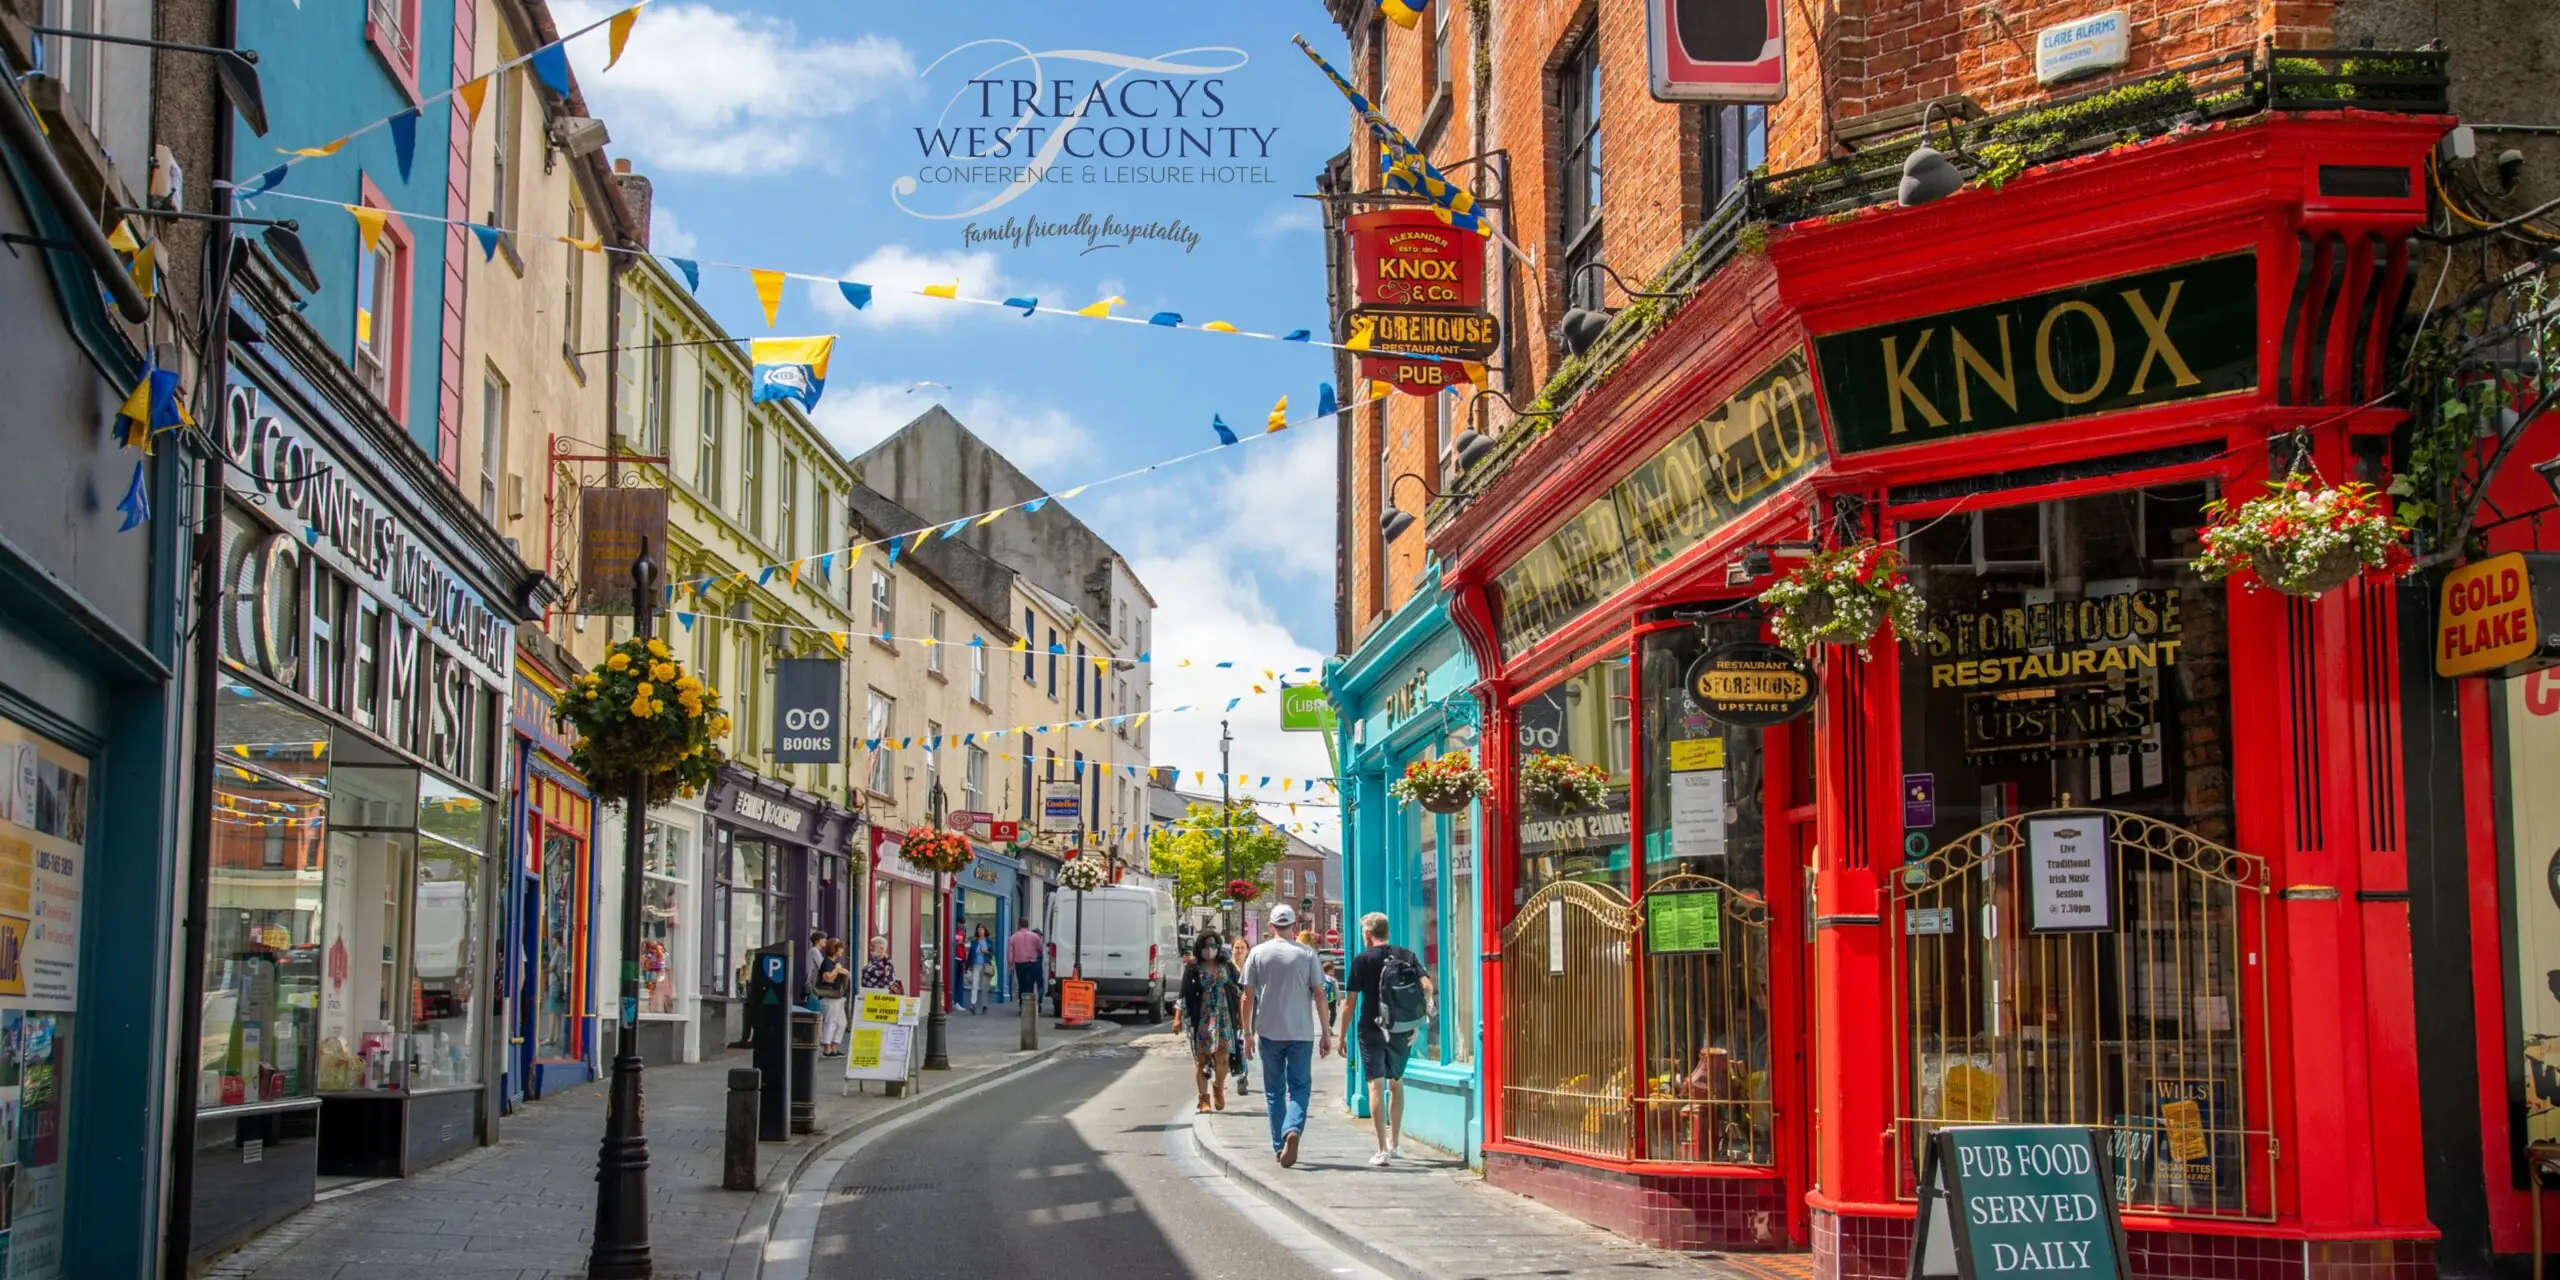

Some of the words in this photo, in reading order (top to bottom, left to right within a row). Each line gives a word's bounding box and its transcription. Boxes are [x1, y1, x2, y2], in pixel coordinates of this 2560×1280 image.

[2044, 30, 2073, 48] CLARE
[2076, 19, 2116, 41] ALARMS
[1388, 232, 1449, 248] ALEXANDER
[1378, 257, 1459, 282] KNOX
[1412, 285, 1425, 302] &
[1428, 286, 1457, 301] Co.
[1382, 343, 1460, 355] RESTAURANT
[1879, 279, 2202, 434] KNOX
[1398, 365, 1443, 386] PUB
[1624, 436, 1719, 565] KNOX
[1750, 375, 1818, 481] CO.
[2448, 568, 2520, 616] GOLD
[393, 533, 474, 652] MEDICAL
[470, 604, 508, 679] HALL
[1927, 588, 2183, 658] STOREHOUSE
[2444, 608, 2528, 660] FLAKE
[252, 532, 480, 784] CHEMIST
[1716, 661, 1788, 670] RESTAURANT
[1932, 640, 2182, 689] RESTAURANT
[1702, 676, 1801, 698] STOREHOUSE
[1718, 703, 1789, 712] UPSTAIRS
[1976, 702, 2145, 741] UPSTAIRS
[782, 736, 832, 752] BOOKS
[741, 793, 766, 821] ENNIS
[762, 800, 802, 833] BOOKSHOP
[2060, 844, 2077, 854] Live
[2047, 858, 2091, 869] Traditional
[2048, 874, 2067, 884] Irish
[2068, 873, 2090, 884] Music
[2055, 888, 2084, 899] Session
[2061, 903, 2091, 914] 7.30pm
[1958, 1145, 2012, 1178] PUB
[2015, 1143, 2091, 1177] FOOD
[1970, 1193, 2098, 1226] SERVED
[1992, 1240, 2092, 1272] DAILY
